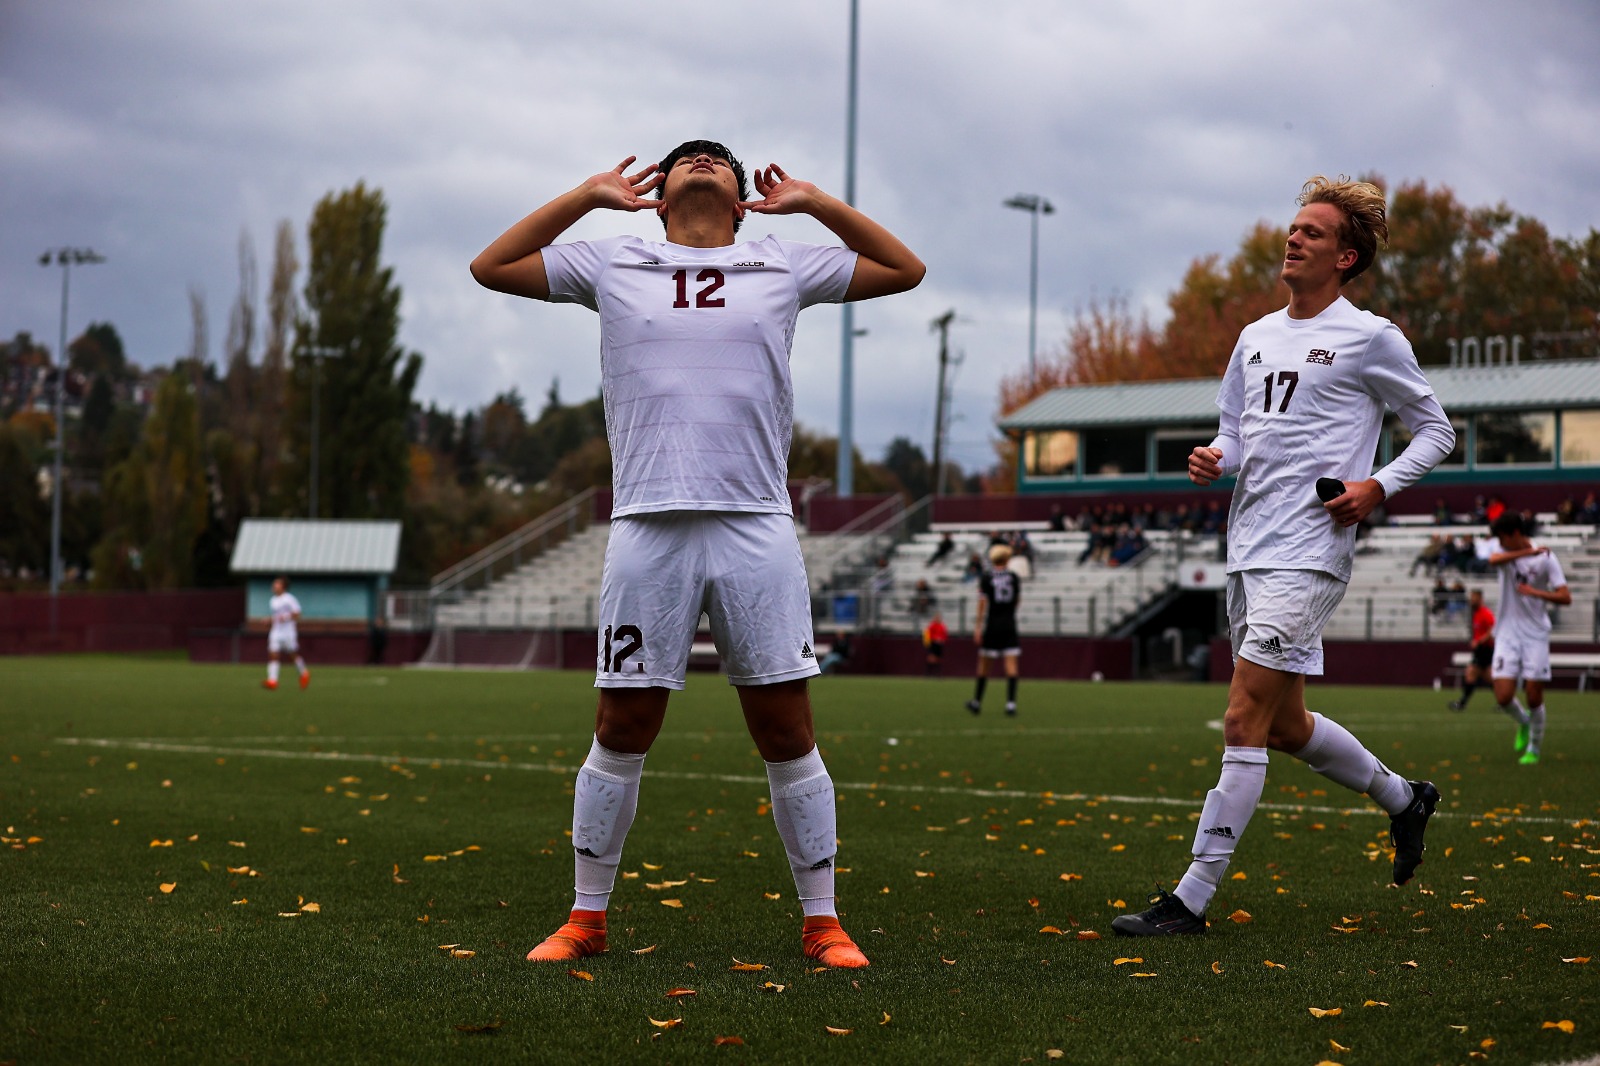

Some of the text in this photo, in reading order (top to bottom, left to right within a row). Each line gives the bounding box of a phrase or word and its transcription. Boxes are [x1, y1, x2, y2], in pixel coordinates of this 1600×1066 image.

[672, 268, 725, 308] 12
[1305, 357, 1333, 366] SOCCER
[1307, 348, 1336, 361] SPU
[1263, 371, 1299, 413] 17
[603, 624, 644, 673] 12
[1203, 829, 1235, 839] adidas
